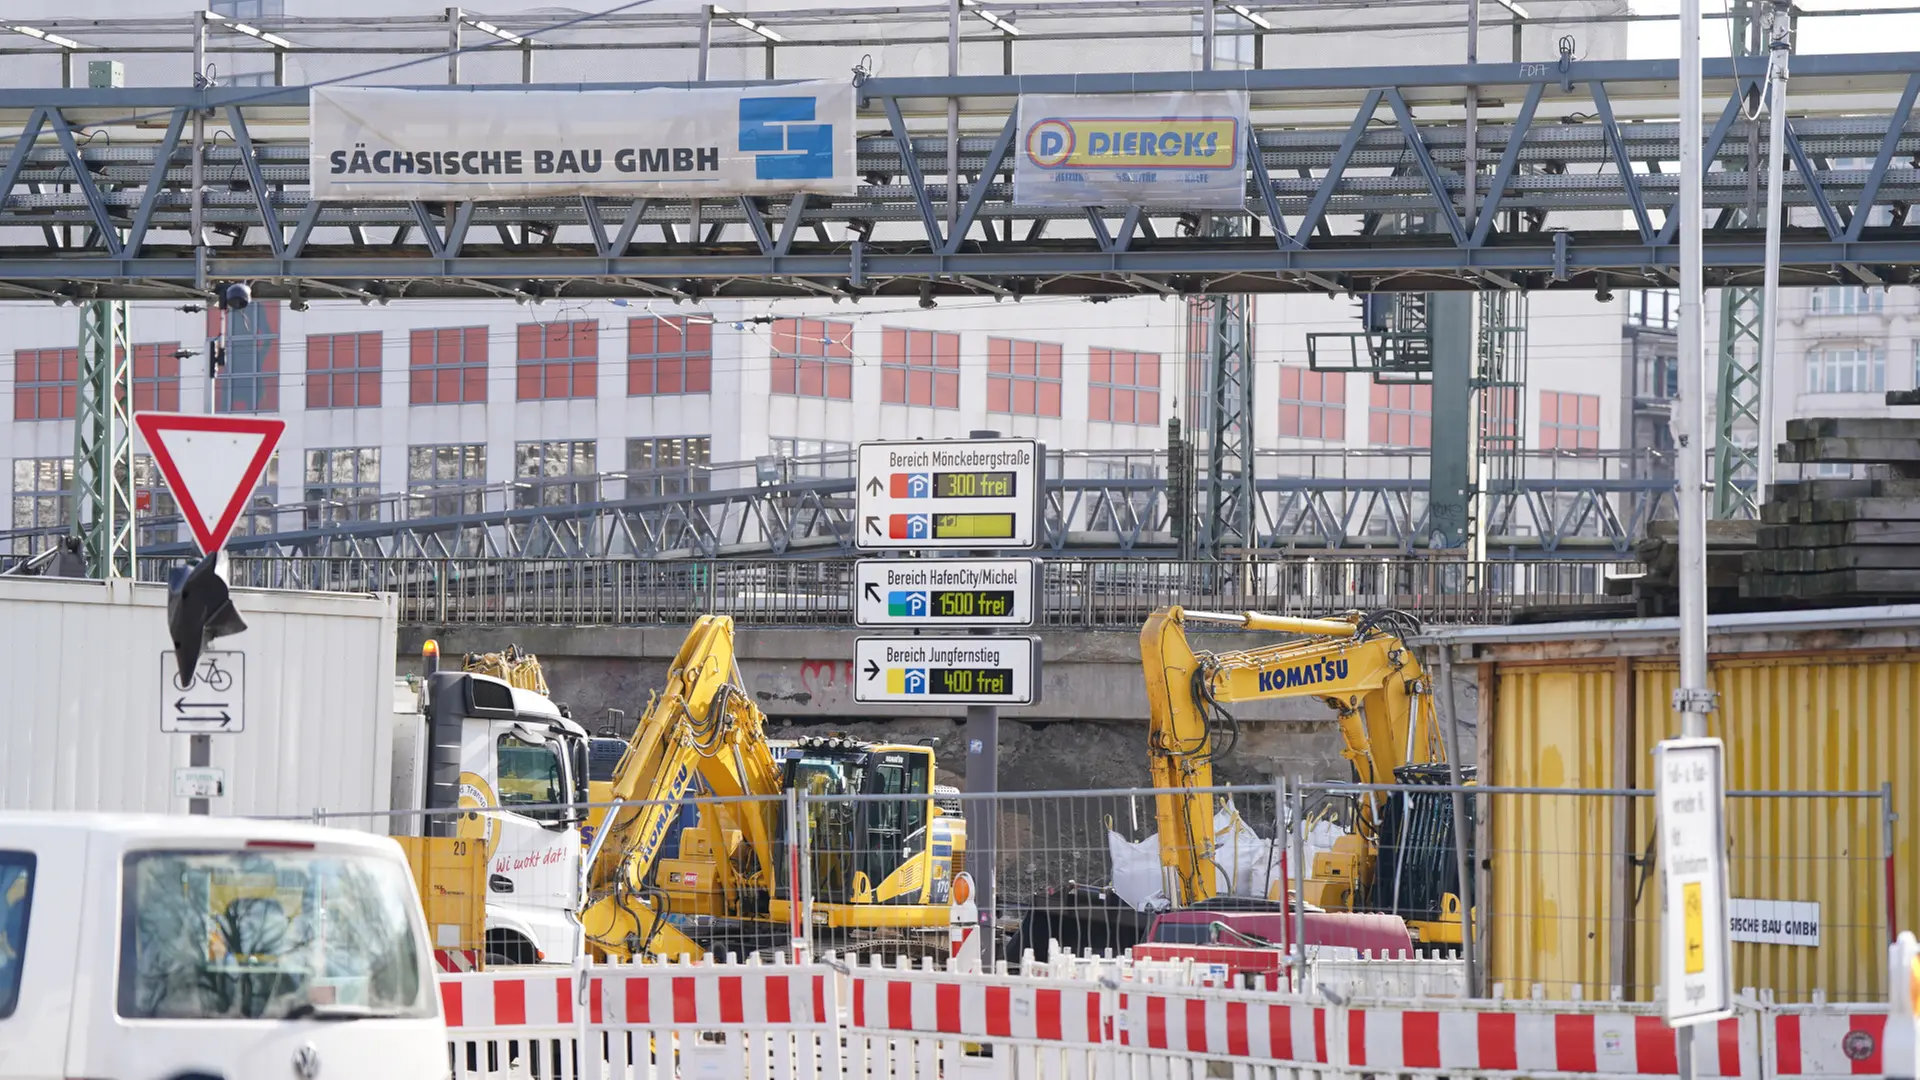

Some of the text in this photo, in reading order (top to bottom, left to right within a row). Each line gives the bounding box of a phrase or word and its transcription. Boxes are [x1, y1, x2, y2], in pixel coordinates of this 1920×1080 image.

[1087, 131, 1219, 157] DIERCKS
[330, 143, 719, 175] SÄCHSISCHE BAU GMBH
[889, 449, 1030, 470] Bereich Mönckebergstraße
[947, 474, 976, 496] 300
[980, 474, 1008, 496] frei
[887, 569, 1018, 588] Bereich HafenCity/Michel
[938, 592, 974, 615] 1500
[978, 592, 1005, 615] frei
[886, 647, 1000, 667] Bereich Jungfernstieg
[943, 670, 972, 693] 400
[976, 670, 1004, 693] frei
[1258, 656, 1348, 692] KOMATSU
[453, 841, 467, 856] 20
[496, 856, 511, 872] Wi
[542, 846, 567, 865] dat!
[937, 880, 950, 893] 170
[1761, 919, 1782, 934] BAU
[1784, 920, 1818, 937] GMBH
